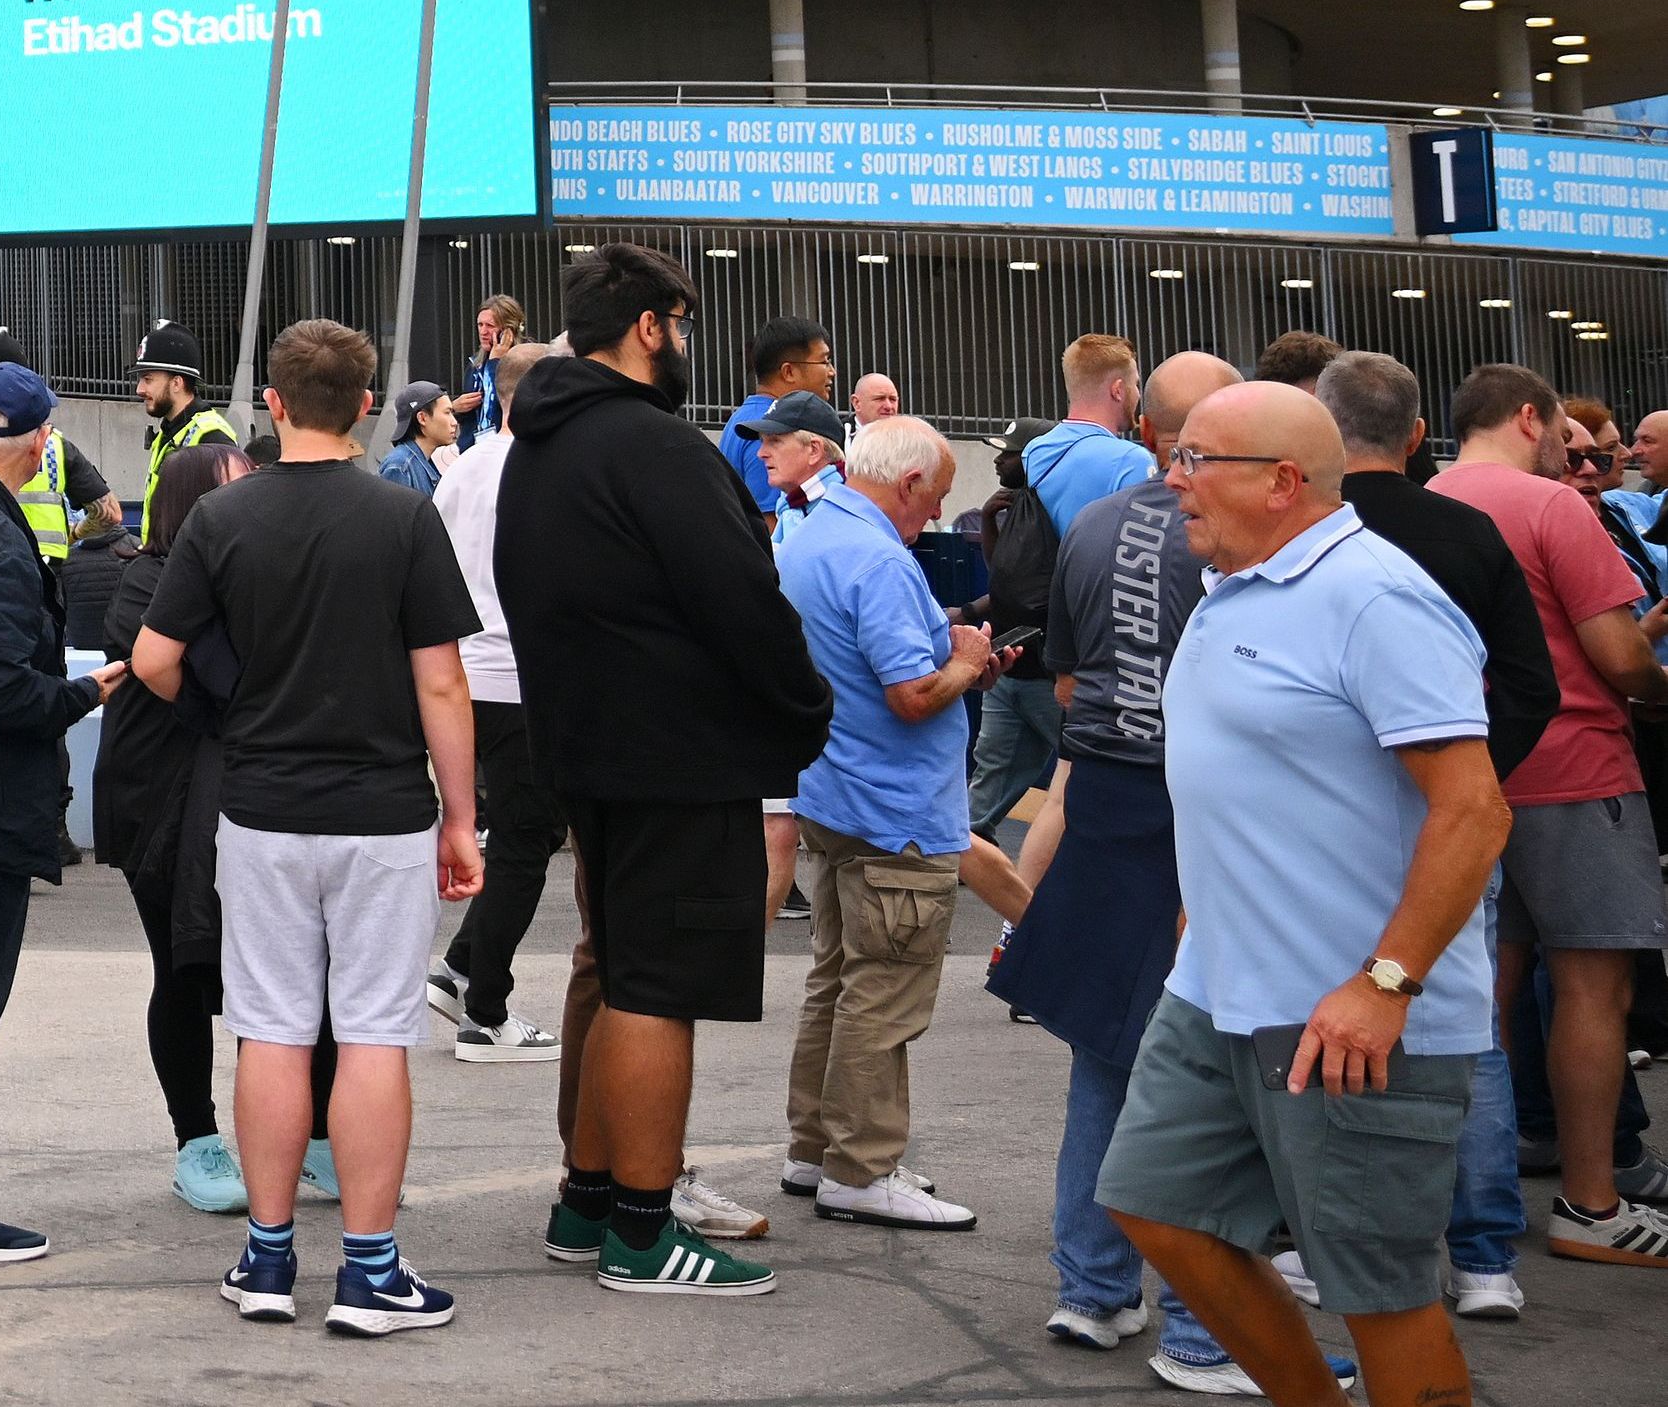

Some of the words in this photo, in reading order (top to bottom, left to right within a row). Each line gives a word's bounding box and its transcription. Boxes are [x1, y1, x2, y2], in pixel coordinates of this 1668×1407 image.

[24, 10, 142, 56] Etihad
[588, 121, 642, 141] BEACH
[648, 121, 700, 142] BLUES
[728, 122, 771, 142] ROSE
[778, 122, 815, 143] CITY
[821, 122, 855, 144] SKY
[860, 123, 915, 144] BLUES
[944, 124, 1042, 146] RUSHOLME
[1066, 127, 1118, 148] MOSS
[1124, 128, 1162, 149] SIDE
[1190, 130, 1246, 152] SABAH
[1272, 132, 1327, 155] SAINT
[1331, 134, 1372, 156] LOUIS
[588, 150, 648, 171] STAFFS
[674, 151, 730, 172] SOUTH
[735, 151, 834, 173] YORKSHIRE
[862, 153, 967, 175] SOUTHPORT
[989, 155, 1039, 176] WEST
[1045, 156, 1101, 178] LANCS
[1129, 158, 1245, 182] STALYBRIDGE
[1250, 162, 1302, 184] BLUES
[1433, 139, 1458, 223] T
[617, 180, 740, 201] ULAANBAATAR
[772, 182, 878, 204] VANCOUVER
[912, 184, 1032, 206] WARRINGTON
[1065, 187, 1156, 210] WARWICK
[1182, 190, 1292, 214] LEAMINGTON
[1111, 500, 1171, 644] FOSTER
[1233, 645, 1257, 659] BOSS
